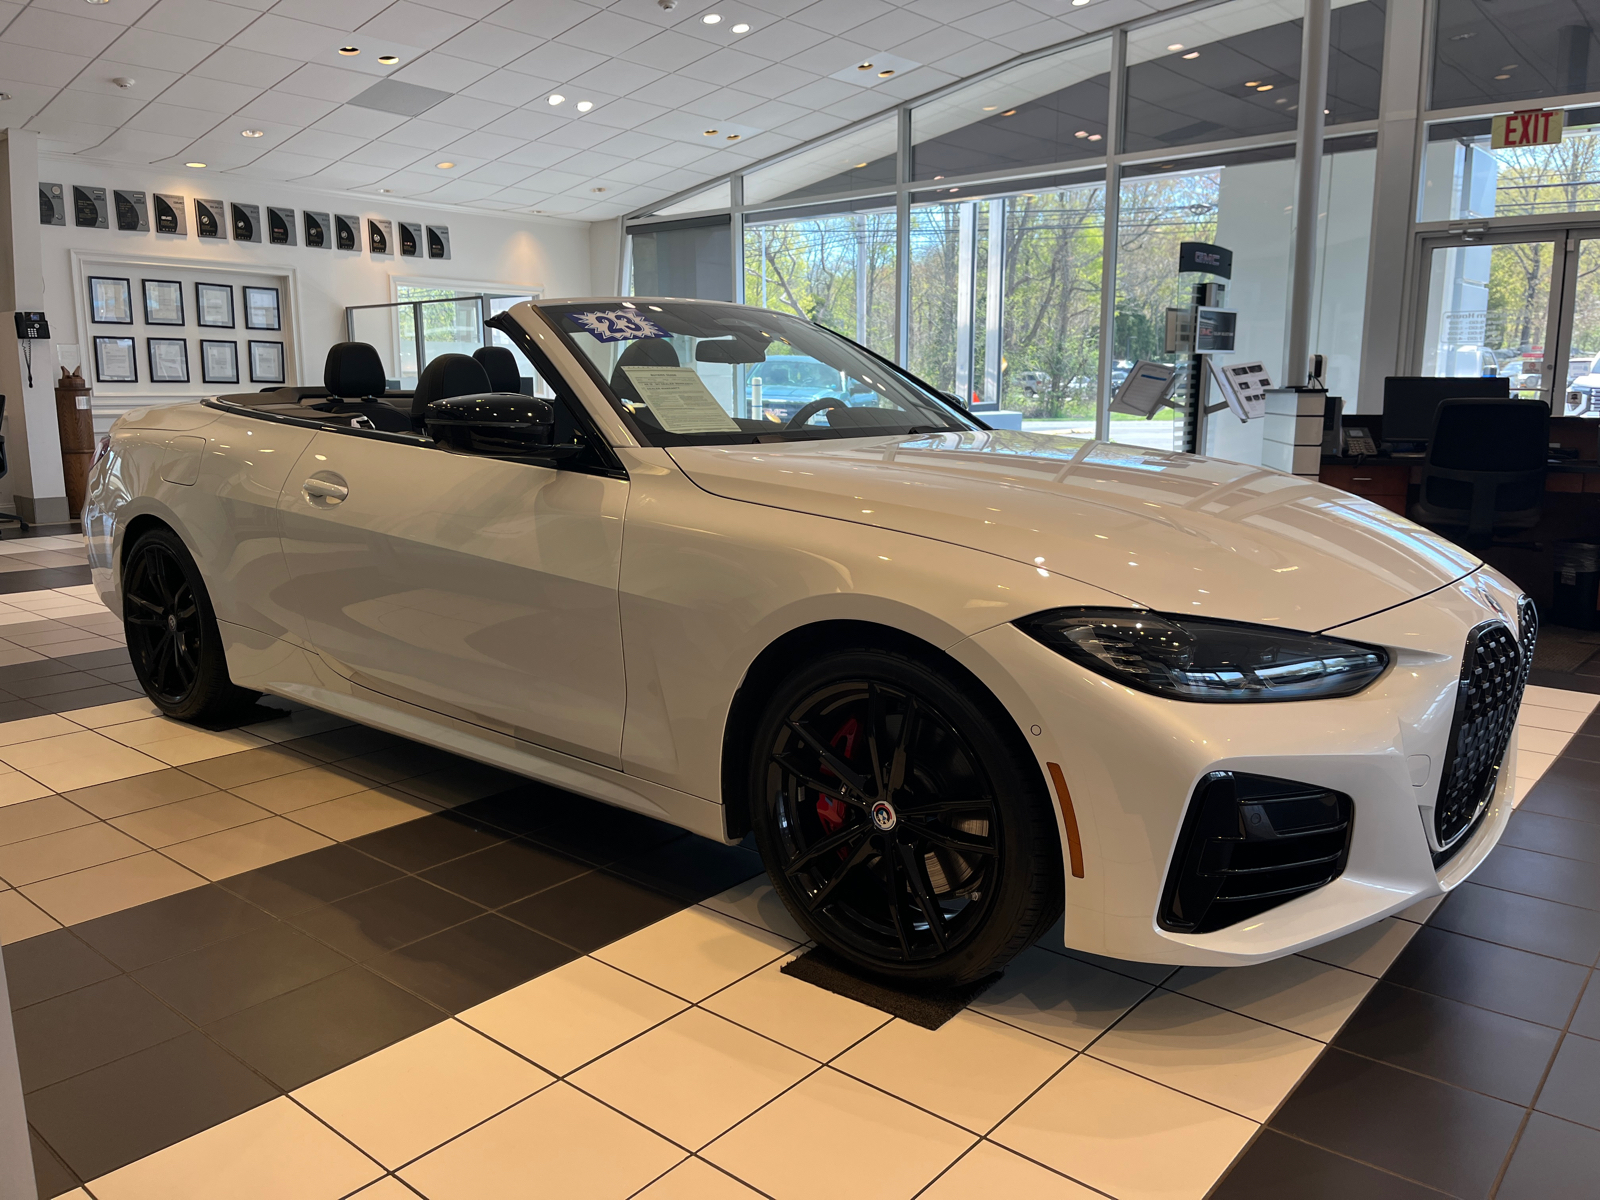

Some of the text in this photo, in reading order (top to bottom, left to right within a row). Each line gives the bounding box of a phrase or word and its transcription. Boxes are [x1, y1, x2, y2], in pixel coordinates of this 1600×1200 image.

[1504, 112, 1553, 146] EXIT
[1195, 251, 1220, 266] GMC
[595, 315, 642, 334] 23
